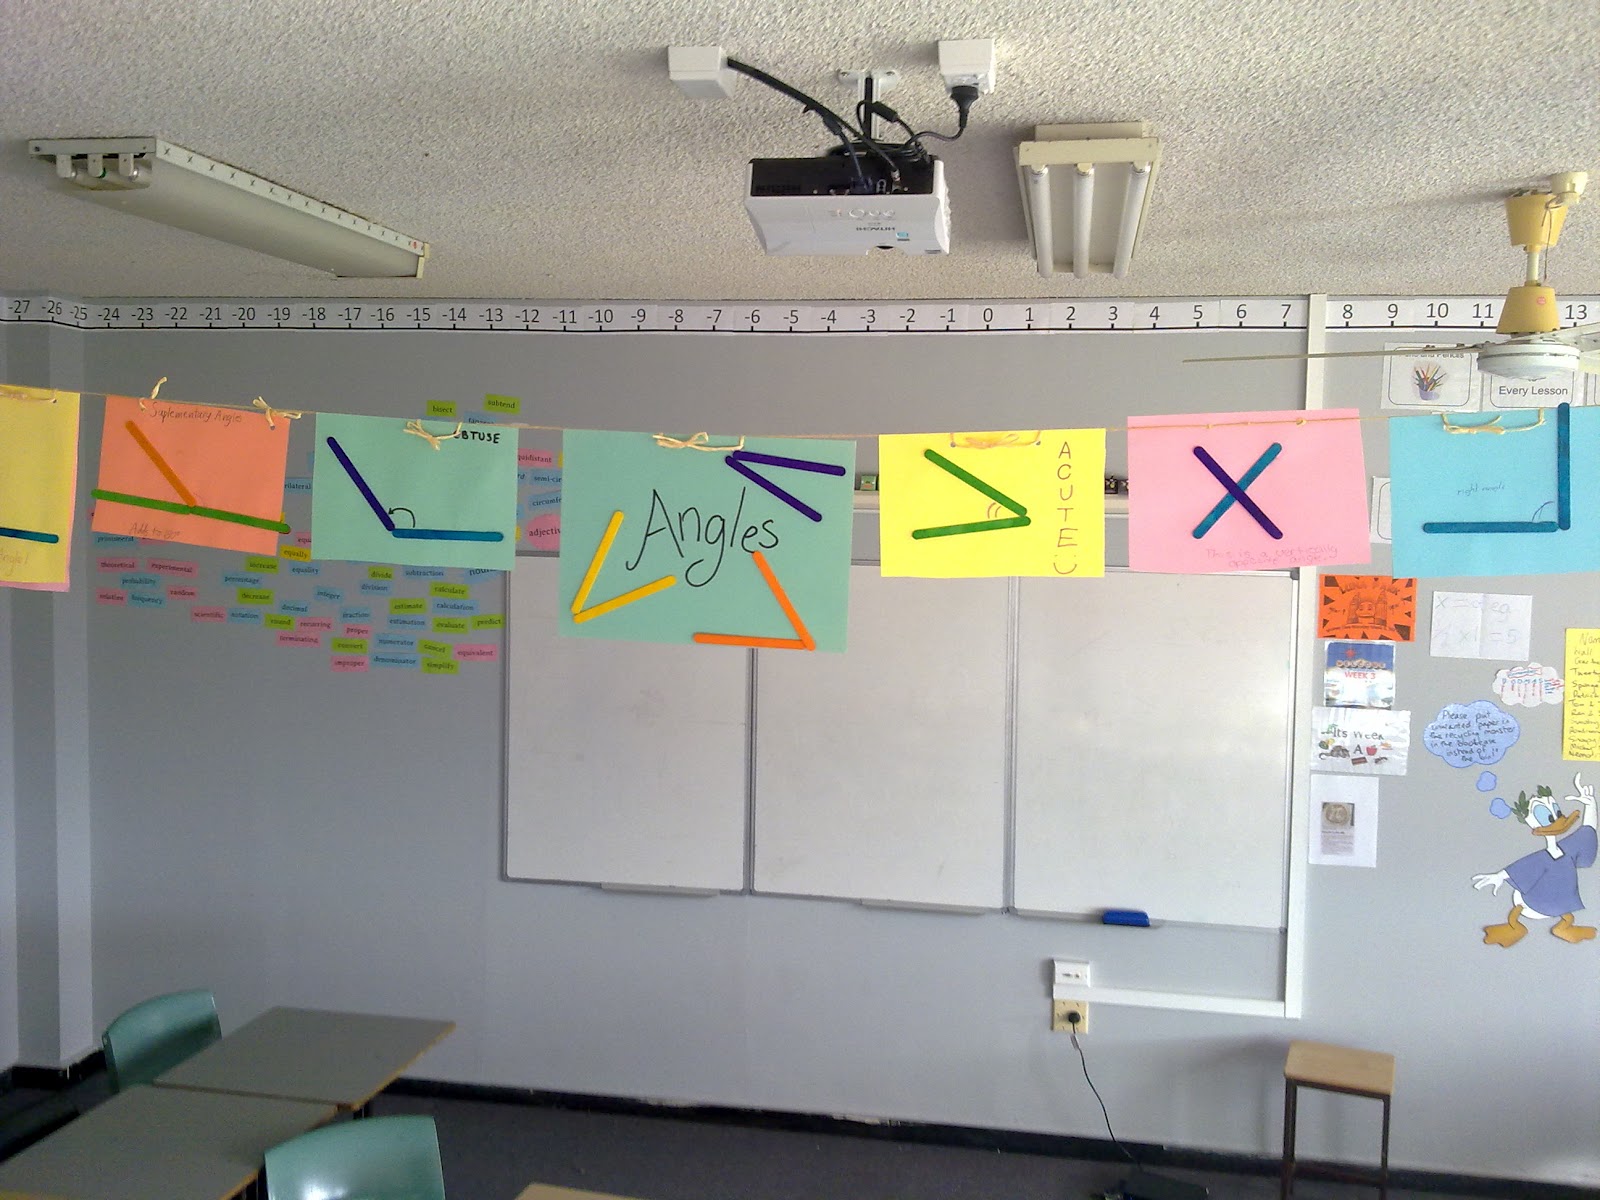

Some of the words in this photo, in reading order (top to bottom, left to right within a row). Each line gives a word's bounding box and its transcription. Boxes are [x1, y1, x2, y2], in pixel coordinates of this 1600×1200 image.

[8, 299, 30, 314] -27
[42, 299, 62, 316] -26
[70, 305, 88, 321] -25
[98, 307, 120, 321] -24
[132, 307, 154, 321] -23
[165, 306, 188, 321] -22
[200, 306, 222, 321] -21
[232, 306, 256, 321] -20
[268, 306, 291, 321] -19
[302, 306, 327, 321] -18
[338, 306, 362, 321] -17
[371, 307, 395, 322] -16
[407, 307, 431, 322] -15
[442, 307, 467, 322] -14
[479, 307, 504, 322] -13
[515, 308, 540, 324] -12
[553, 309, 578, 324] -11
[589, 308, 614, 324] -10
[631, 308, 647, 324] -9
[668, 308, 685, 324] -8
[707, 308, 723, 324] -7
[745, 308, 761, 324] -6
[784, 309, 799, 325] -5
[821, 309, 838, 325] -4
[860, 308, 876, 324] -3
[900, 307, 916, 324] -2
[940, 307, 956, 323] -1
[982, 307, 994, 323] 0
[1024, 306, 1035, 322] 1
[1065, 306, 1076, 321] 2
[1108, 305, 1119, 321] 3
[1149, 305, 1161, 321] 4
[1192, 304, 1204, 320] 5
[1236, 303, 1248, 320] 6
[1280, 303, 1292, 320] 7
[1342, 303, 1354, 320] 8
[1387, 303, 1399, 319] 9
[1426, 302, 1450, 319] 10
[1472, 302, 1495, 319] 11
[1565, 303, 1588, 320] 13
[1498, 385, 1529, 397] Every
[1531, 385, 1569, 395] Lesson
[432, 405, 453, 414] bisect
[487, 399, 516, 410] subtend
[518, 454, 552, 464] quidistant
[533, 474, 562, 483] semi-cir
[284, 481, 312, 491] rilateral
[1055, 441, 1079, 548] ACUTE
[531, 497, 562, 507] circumf
[528, 525, 561, 539] adjectiv
[626, 486, 780, 587] Angles
[151, 562, 193, 573] experimental
[291, 565, 319, 575] equality
[370, 570, 393, 579] divide
[405, 569, 445, 577] subtraction
[121, 576, 157, 586] probability
[223, 575, 261, 586] percentage
[170, 588, 195, 597] random
[361, 583, 389, 592] division
[434, 585, 466, 595] calculate
[241, 592, 270, 600] decrease
[281, 603, 308, 613] decimal
[394, 602, 424, 610] estimate
[436, 602, 475, 612] calculation
[193, 610, 225, 619] scientific
[231, 611, 259, 619] notation
[342, 610, 370, 619] fraction
[270, 618, 292, 626] round
[300, 620, 331, 630] recurring
[389, 618, 426, 626] estimation
[436, 621, 466, 630] evaluate
[477, 618, 501, 627] predict
[346, 626, 369, 636] proper
[279, 634, 320, 644] terminating
[378, 638, 415, 647] numerator
[337, 642, 364, 650] convert
[423, 643, 446, 654] cancel
[457, 649, 494, 658] equivalent
[334, 659, 365, 668] improper
[373, 655, 417, 665] denominator
[426, 661, 455, 671] simplify
[1344, 671, 1369, 679] WEEK
[1370, 672, 1377, 680] 3
[1442, 709, 1468, 720] Please
[1475, 709, 1491, 723] put
[1478, 719, 1500, 731] paper
[1484, 725, 1516, 735] monster
[1353, 743, 1364, 755] A
